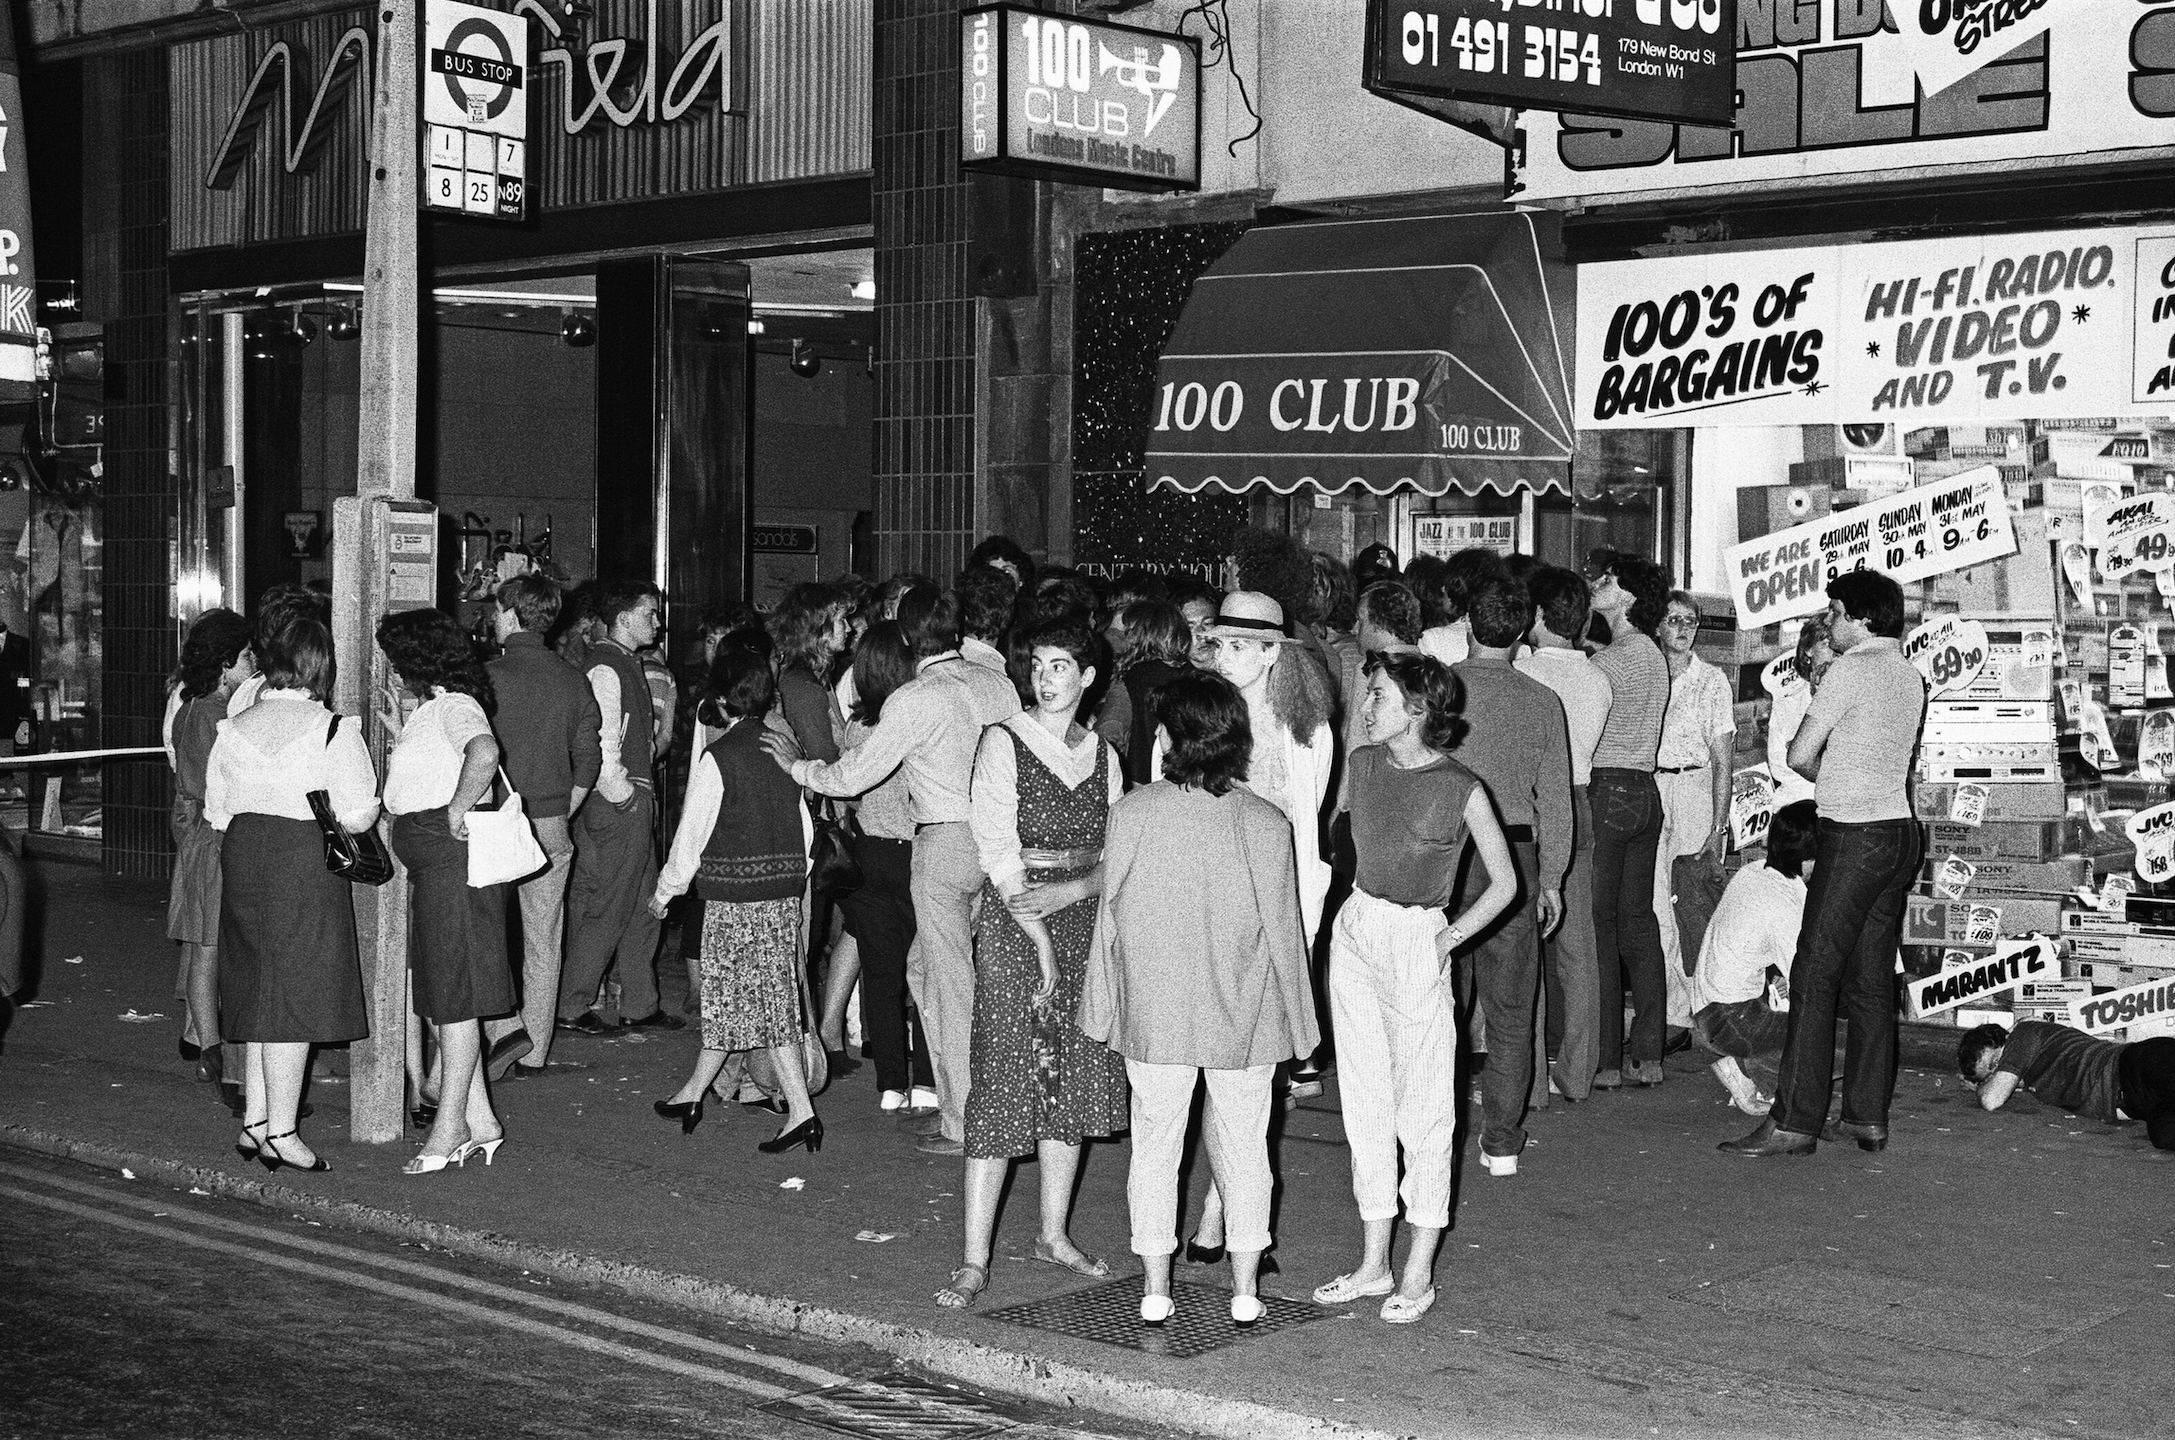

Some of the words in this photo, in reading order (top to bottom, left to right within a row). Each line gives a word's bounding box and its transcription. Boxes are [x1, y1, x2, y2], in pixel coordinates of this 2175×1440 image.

[973, 13, 988, 76] 100
[1022, 15, 1090, 93] 100
[1402, 11, 1439, 66] 01
[1450, 16, 1509, 75] 491
[1524, 24, 1602, 86] 3154
[1618, 38, 1638, 54] 179
[1640, 41, 1667, 58] New
[1669, 44, 1700, 63] Bond
[1703, 50, 1716, 66] St
[444, 54, 474, 74] BUS
[481, 62, 513, 82] STOP
[1618, 56, 1661, 77] London
[1665, 64, 1684, 79] W1
[973, 81, 986, 154] CLUB
[1025, 87, 1129, 137] CLUB
[507, 143, 515, 162] 7
[441, 178, 451, 197] 8
[471, 182, 488, 202] 25
[500, 181, 521, 202] N89
[501, 204, 519, 214] NIGHT
[1603, 283, 1739, 362] 100'S
[1753, 272, 1815, 328] OF
[1896, 300, 2061, 367] VIDEO
[1594, 329, 1823, 420] BARGAINS
[1872, 370, 1954, 412] AND
[1977, 352, 2067, 399] T.V.
[1153, 381, 1244, 431] 100
[1269, 378, 1420, 433] CLUB
[1441, 424, 1469, 449] 100
[1474, 425, 1521, 451] CLUB
[1932, 485, 1972, 515] MONDAY
[1962, 501, 1986, 521] MAY
[2107, 501, 2154, 525] AKAI
[1420, 522, 1442, 539] JAZZ
[1470, 522, 1485, 538] 100
[1489, 522, 1511, 539] CLUB
[1879, 502, 1922, 532] SUNDAY
[1908, 521, 1927, 538] MAY
[753, 527, 798, 547] sandals
[1820, 519, 1869, 551] SATURDAY
[1848, 539, 1870, 557] MAY
[1741, 550, 1771, 579] WE
[1774, 537, 1811, 567] ARE
[1075, 562, 1175, 584] ENTY
[1745, 558, 1821, 614] OPEN
[1904, 632, 1929, 660] JVC
[1935, 825, 1970, 833] SONY
[2137, 811, 2173, 834] JVC
[1950, 904, 1971, 913] SO
[1922, 945, 2045, 1010] MARANTZ
